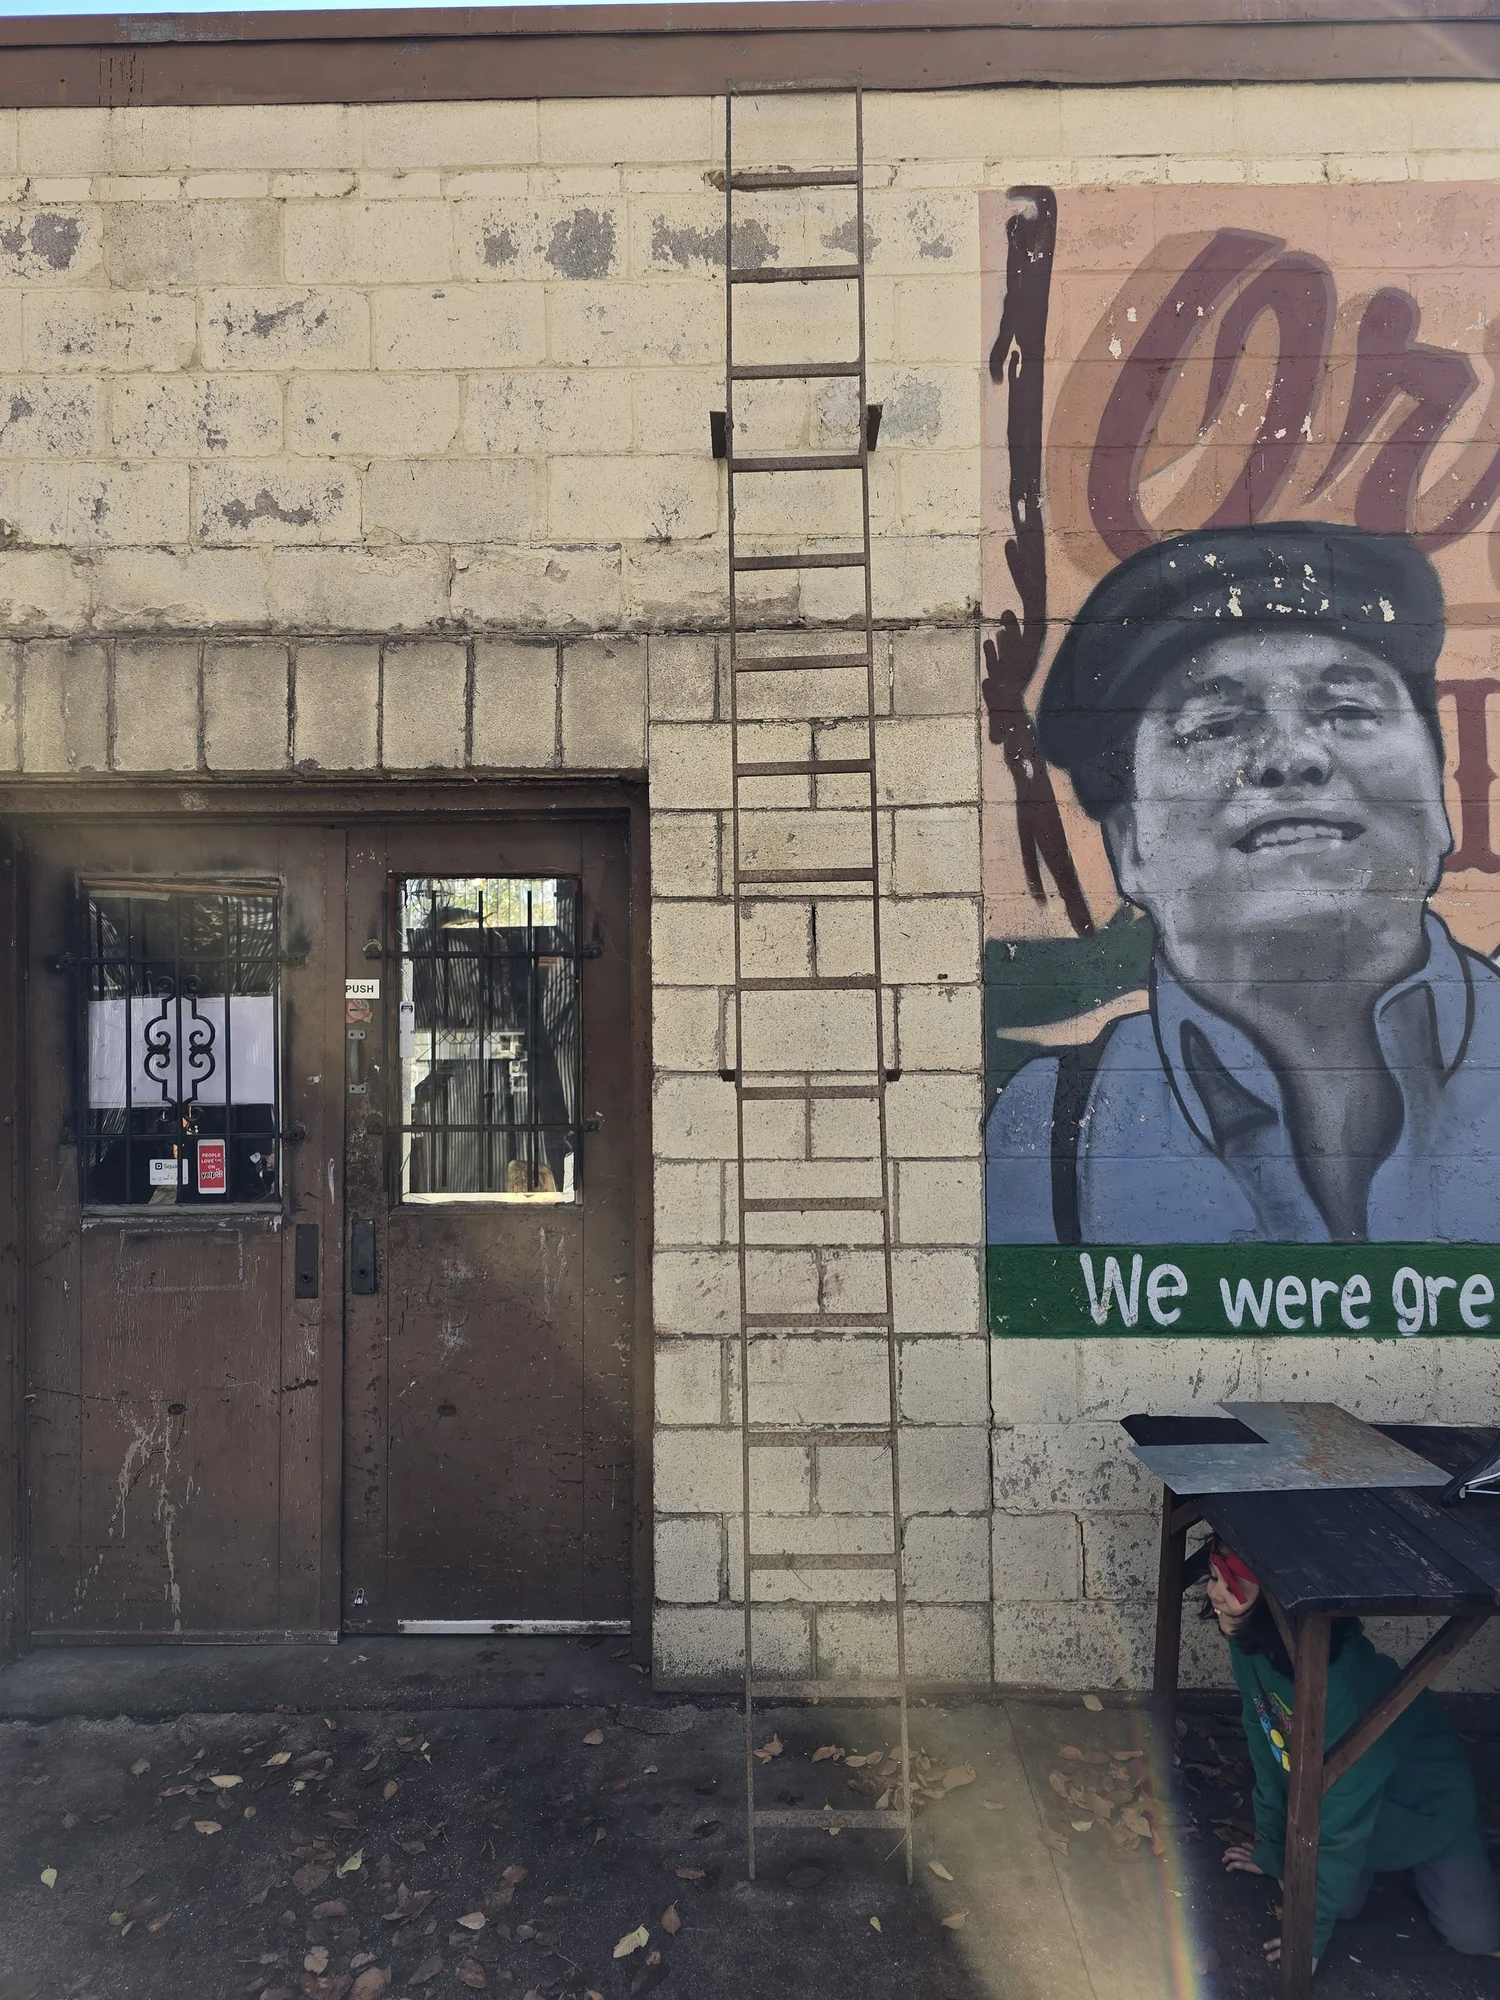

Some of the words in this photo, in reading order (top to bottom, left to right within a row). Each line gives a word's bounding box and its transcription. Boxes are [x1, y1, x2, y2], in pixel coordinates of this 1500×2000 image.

[346, 984, 374, 993] PUSH
[201, 1171, 216, 1179] yelp
[1079, 1252, 1188, 1327] We
[1219, 1274, 1372, 1329] were
[1392, 1266, 1496, 1337] gre
